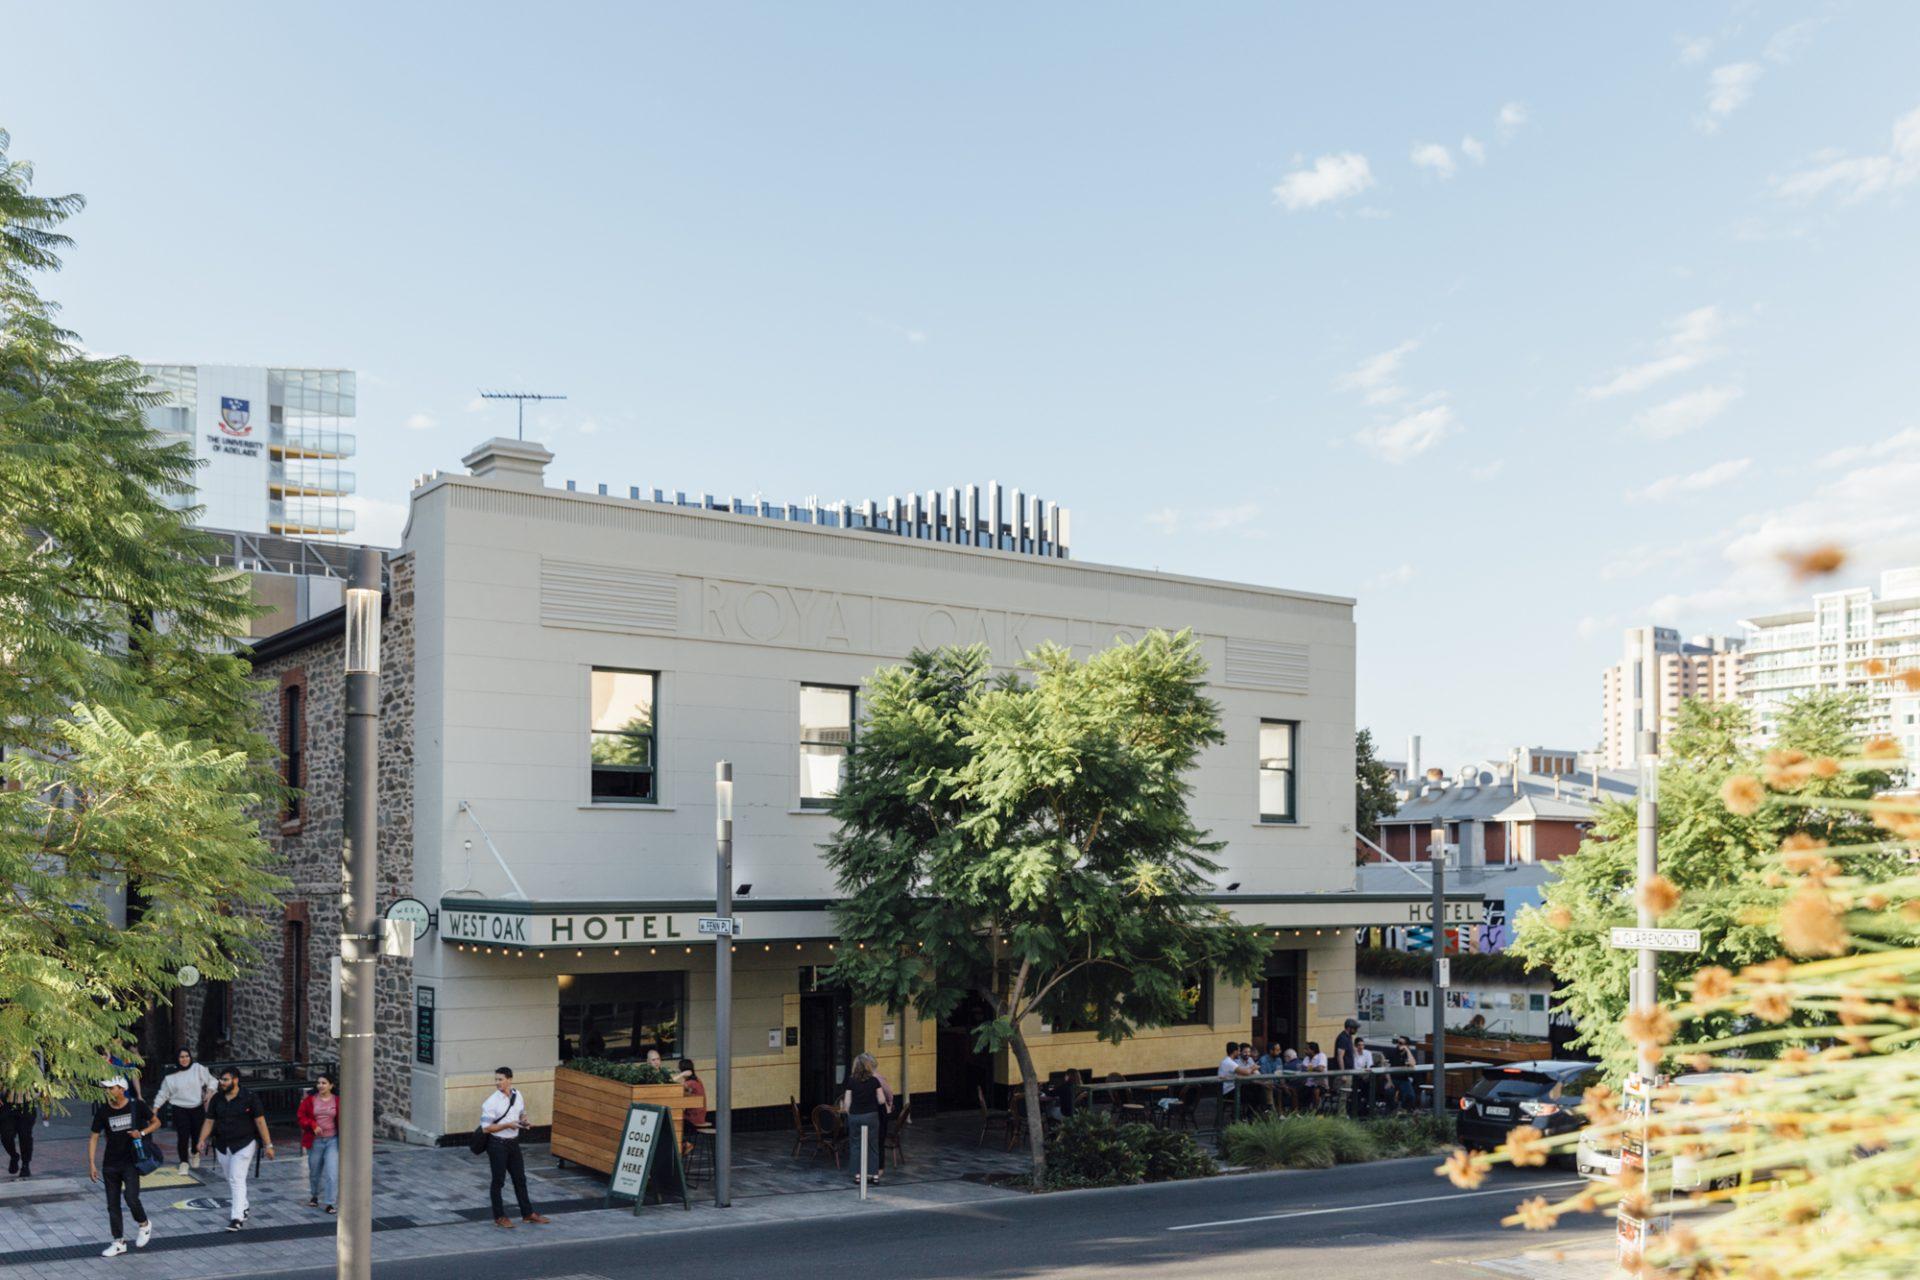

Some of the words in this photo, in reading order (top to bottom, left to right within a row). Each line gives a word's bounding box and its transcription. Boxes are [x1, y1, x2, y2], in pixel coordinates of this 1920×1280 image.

[207, 435, 219, 443] THE
[222, 438, 263, 449] UNIVERSITY
[224, 446, 257, 457] ADELAIDE
[701, 576, 888, 652] ROYAL
[918, 603, 1028, 662] OAK
[450, 913, 488, 938] WEST
[492, 917, 526, 942] OAK
[551, 915, 681, 941] HOTEL
[706, 921, 720, 931] FENN
[721, 921, 729, 932] PL
[1624, 932, 1680, 946] CLARENDON
[1682, 934, 1694, 947] ST
[628, 1131, 651, 1143] COLD
[626, 1146, 645, 1158] BEER
[621, 1161, 643, 1174] HERE
